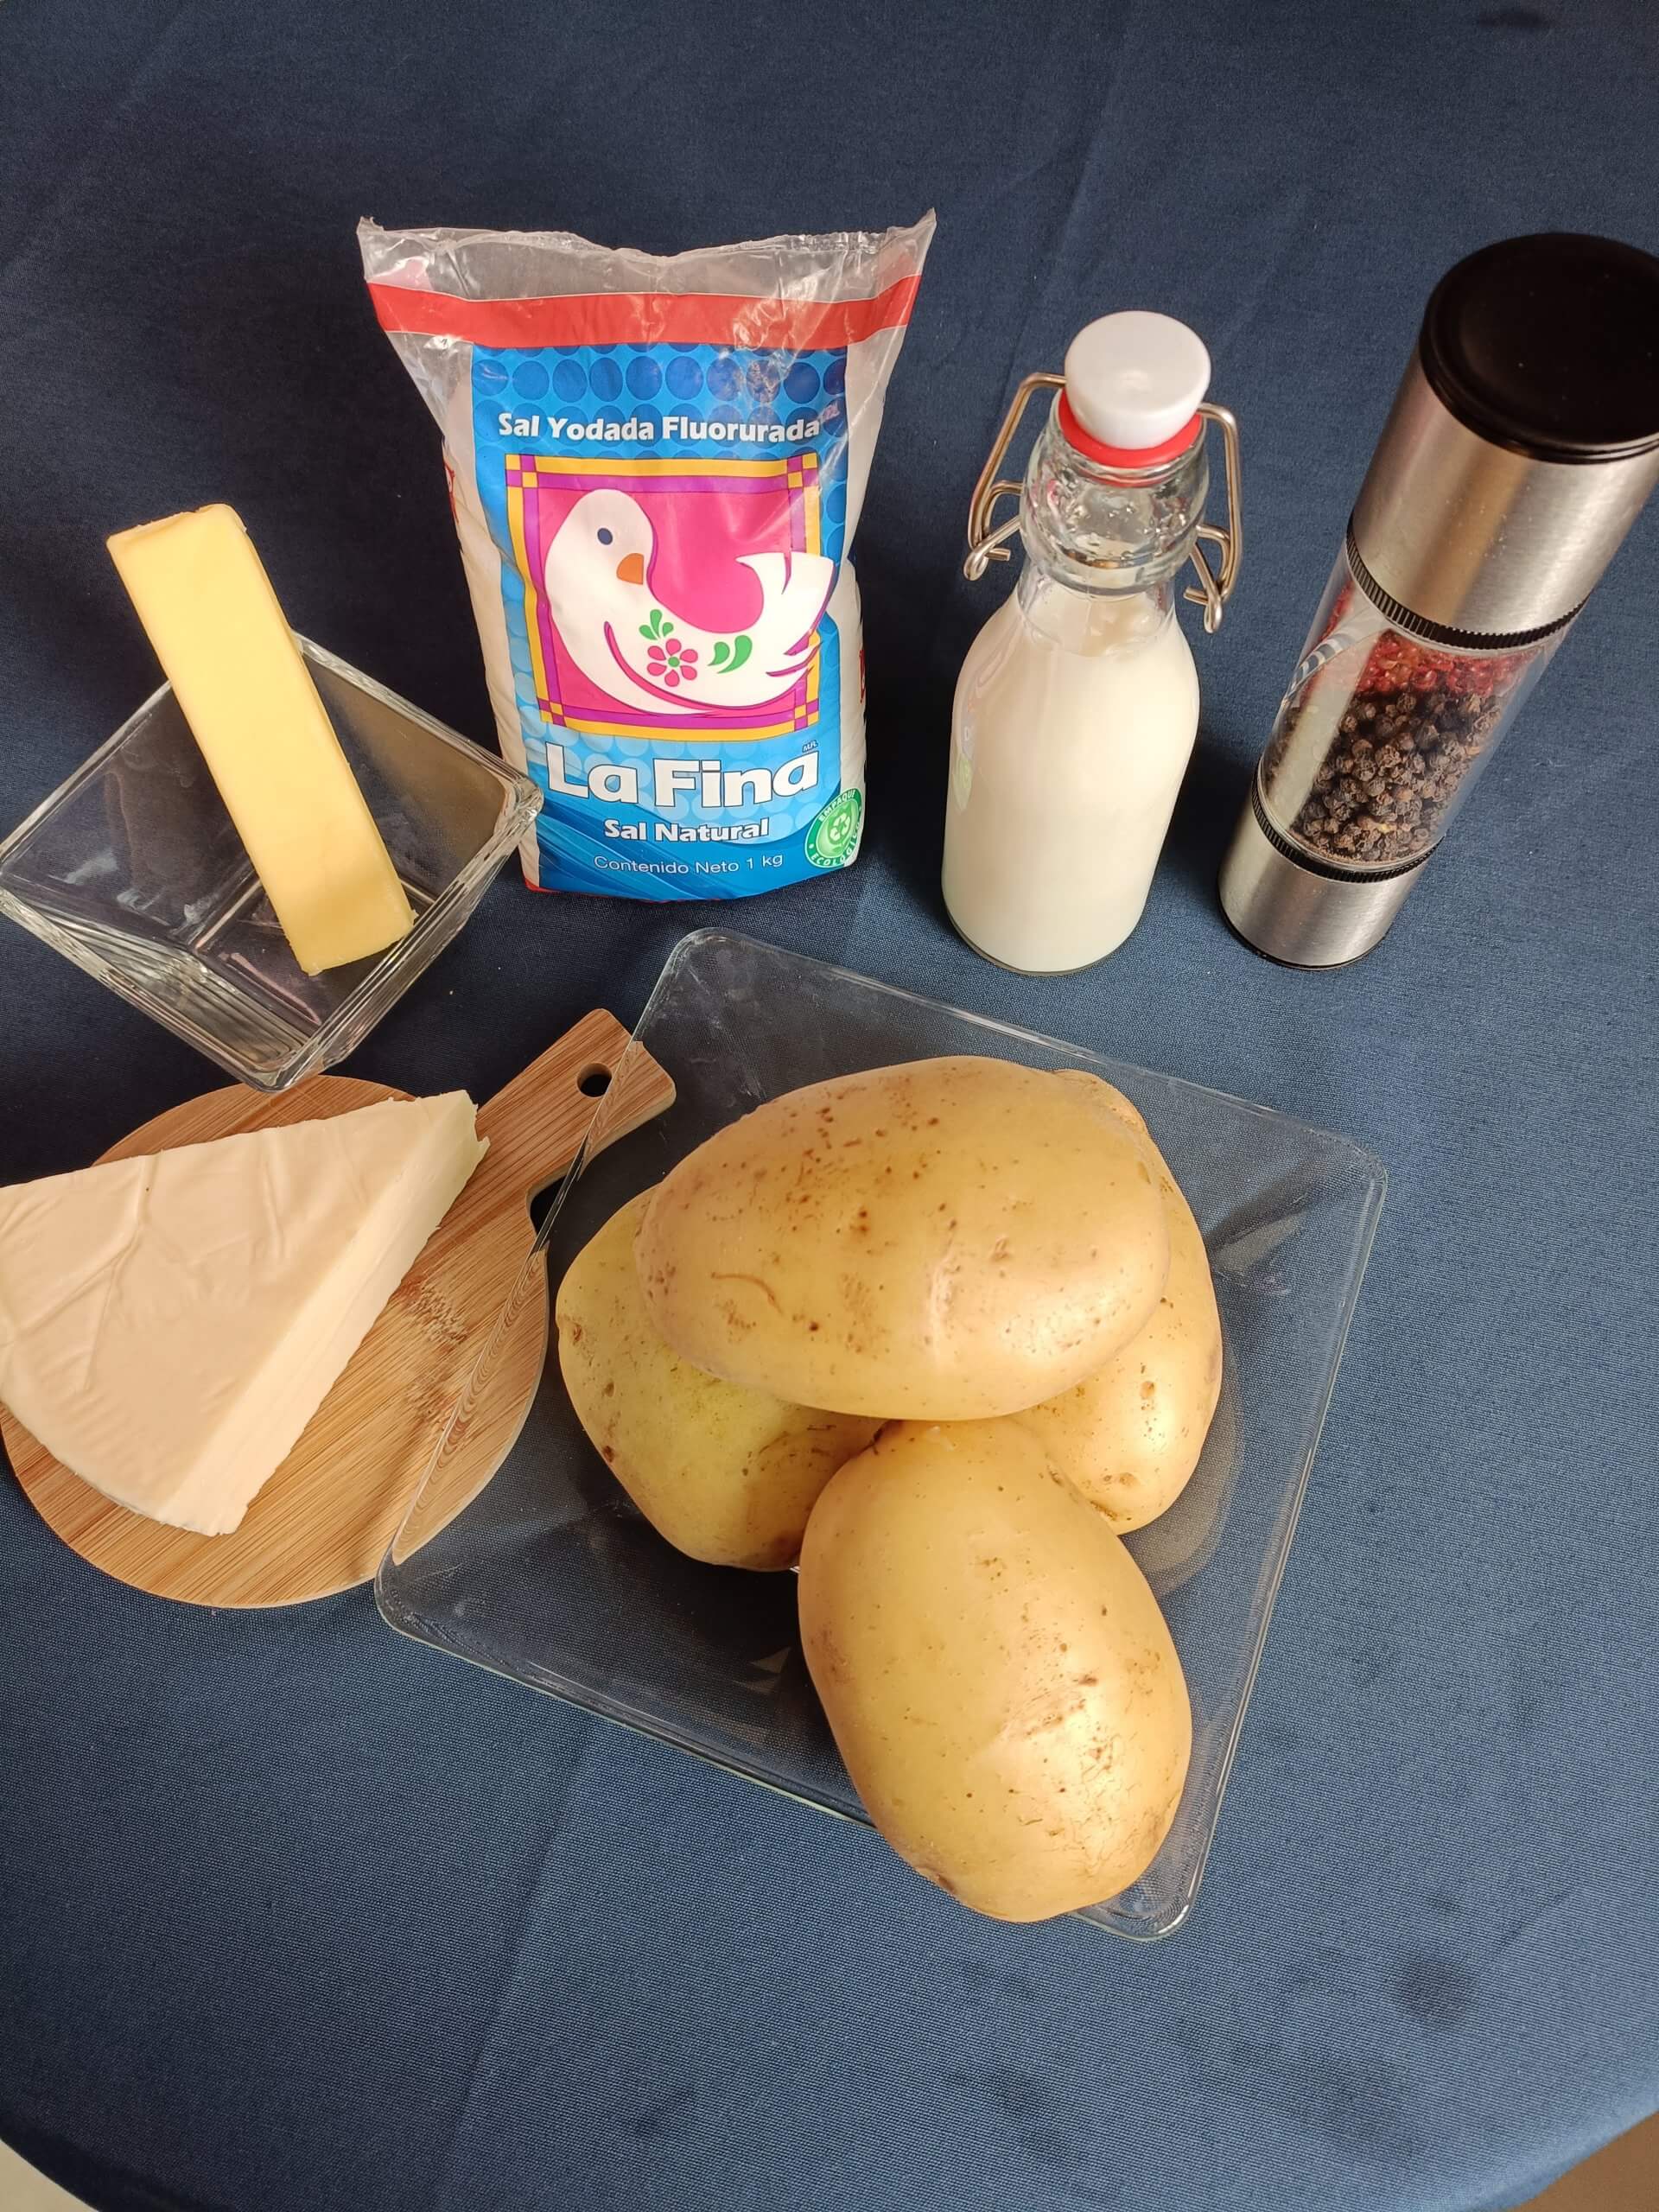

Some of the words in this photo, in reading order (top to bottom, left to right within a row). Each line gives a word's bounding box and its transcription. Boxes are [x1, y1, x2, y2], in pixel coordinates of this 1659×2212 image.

[498, 412, 539, 437] Sal
[547, 416, 654, 441] Yodada
[662, 416, 821, 442] Fluorurada
[545, 741, 639, 804] La
[653, 750, 820, 809] Fina
[604, 818, 647, 842] Sal
[654, 817, 770, 843] Natural
[594, 855, 690, 875] Contenido
[696, 857, 740, 874] Neto
[746, 857, 754, 869] 1
[761, 854, 784, 868] kg
